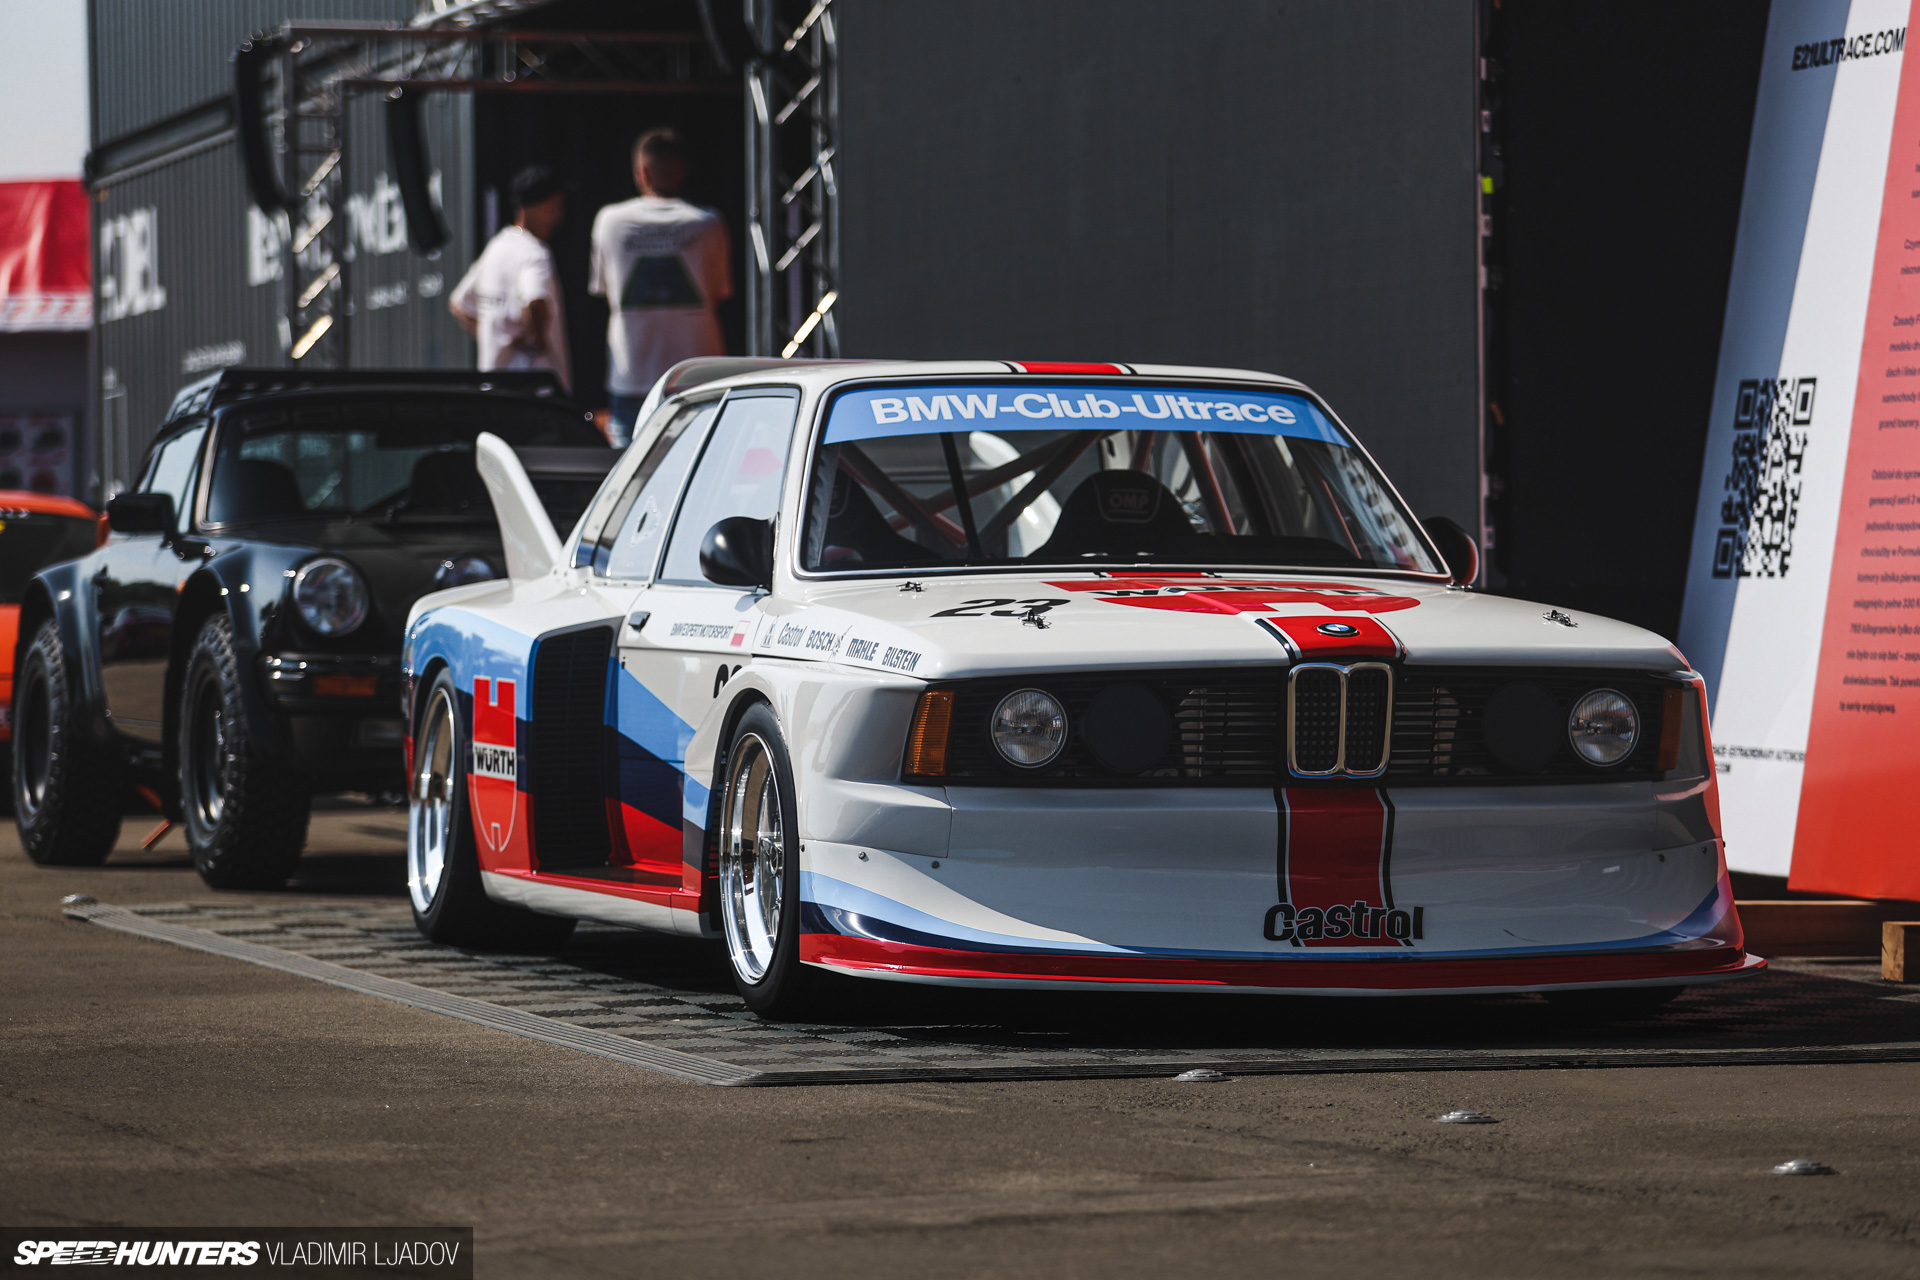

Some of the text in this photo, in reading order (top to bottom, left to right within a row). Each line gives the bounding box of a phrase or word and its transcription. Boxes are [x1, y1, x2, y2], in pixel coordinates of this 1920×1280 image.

[870, 393, 1297, 424] BMW-Club-Ultrace
[930, 599, 1071, 617] 23
[777, 622, 922, 672] Castrol BOSCH MAHLE BILSTEIN
[1263, 900, 1424, 942] Castrol
